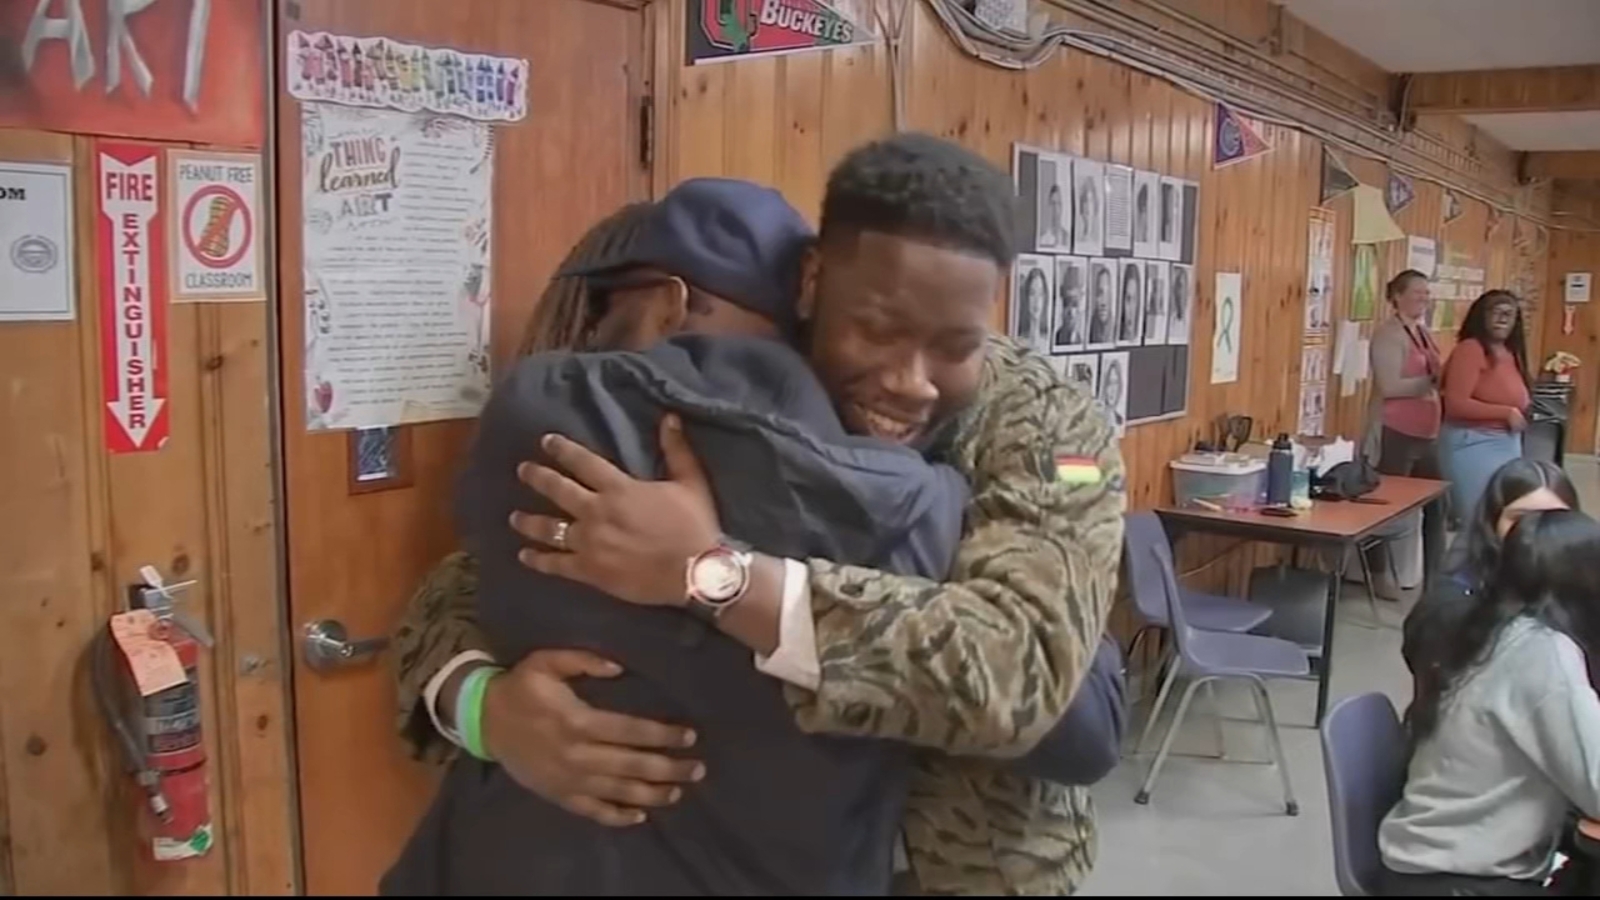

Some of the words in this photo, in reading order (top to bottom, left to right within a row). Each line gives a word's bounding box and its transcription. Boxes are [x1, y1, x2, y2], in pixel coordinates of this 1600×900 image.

[760, 0, 853, 43] BUCKEYES
[329, 136, 387, 169] THING
[179, 163, 224, 182] PEANUT
[227, 165, 253, 184] FREE
[319, 145, 401, 194] learned
[105, 171, 154, 202] FIRE
[185, 271, 253, 289] CLASSROOM
[121, 212, 147, 430] EXTINGUISHER
